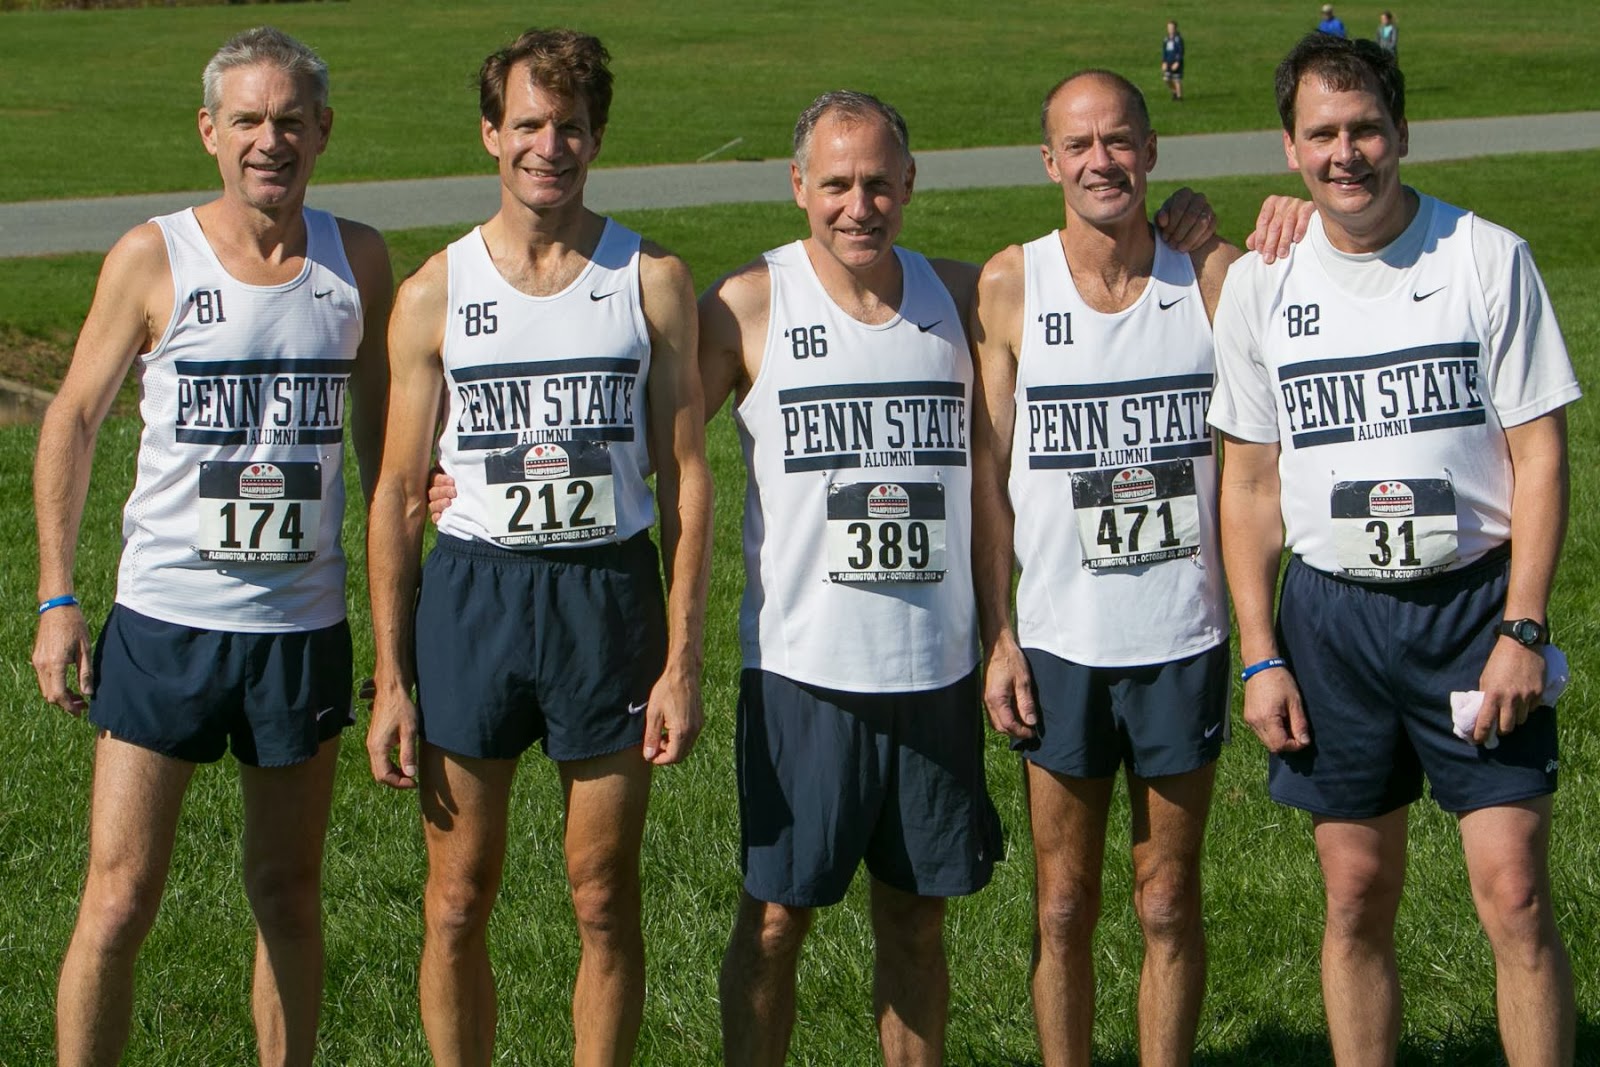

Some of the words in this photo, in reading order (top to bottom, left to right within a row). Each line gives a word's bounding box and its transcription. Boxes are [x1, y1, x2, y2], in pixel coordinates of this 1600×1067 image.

[458, 301, 498, 336] '85
[1038, 312, 1074, 346] '81
[785, 325, 828, 360] '86
[176, 377, 262, 428] PENN
[273, 377, 348, 428] STAT
[457, 380, 532, 432] PENN
[543, 375, 636, 426] STATE
[1281, 374, 1367, 431] PENN
[1377, 360, 1484, 419] STATE
[250, 429, 298, 445] ALUMNI
[521, 428, 570, 445] ALUMNI
[781, 401, 874, 456] PENN
[885, 399, 966, 449] STATE
[1028, 401, 1110, 452] PENN
[1358, 419, 1409, 441] ALUMNI
[864, 451, 913, 468] ALUMNI
[1099, 447, 1149, 467] ALUMNI
[505, 480, 596, 532] 212
[220, 502, 304, 549] 174
[552, 531, 580, 541] OCTOBER
[591, 527, 606, 537] 2013
[1097, 501, 1180, 554] 471
[1365, 520, 1421, 566] 31
[260, 552, 287, 561] OCTOBER
[847, 521, 930, 570] 389
[1141, 552, 1167, 562] OCTOBER
[1177, 548, 1192, 557] 2013
[890, 572, 915, 581] OCTOBER
[1394, 569, 1421, 579] OCTOBER
